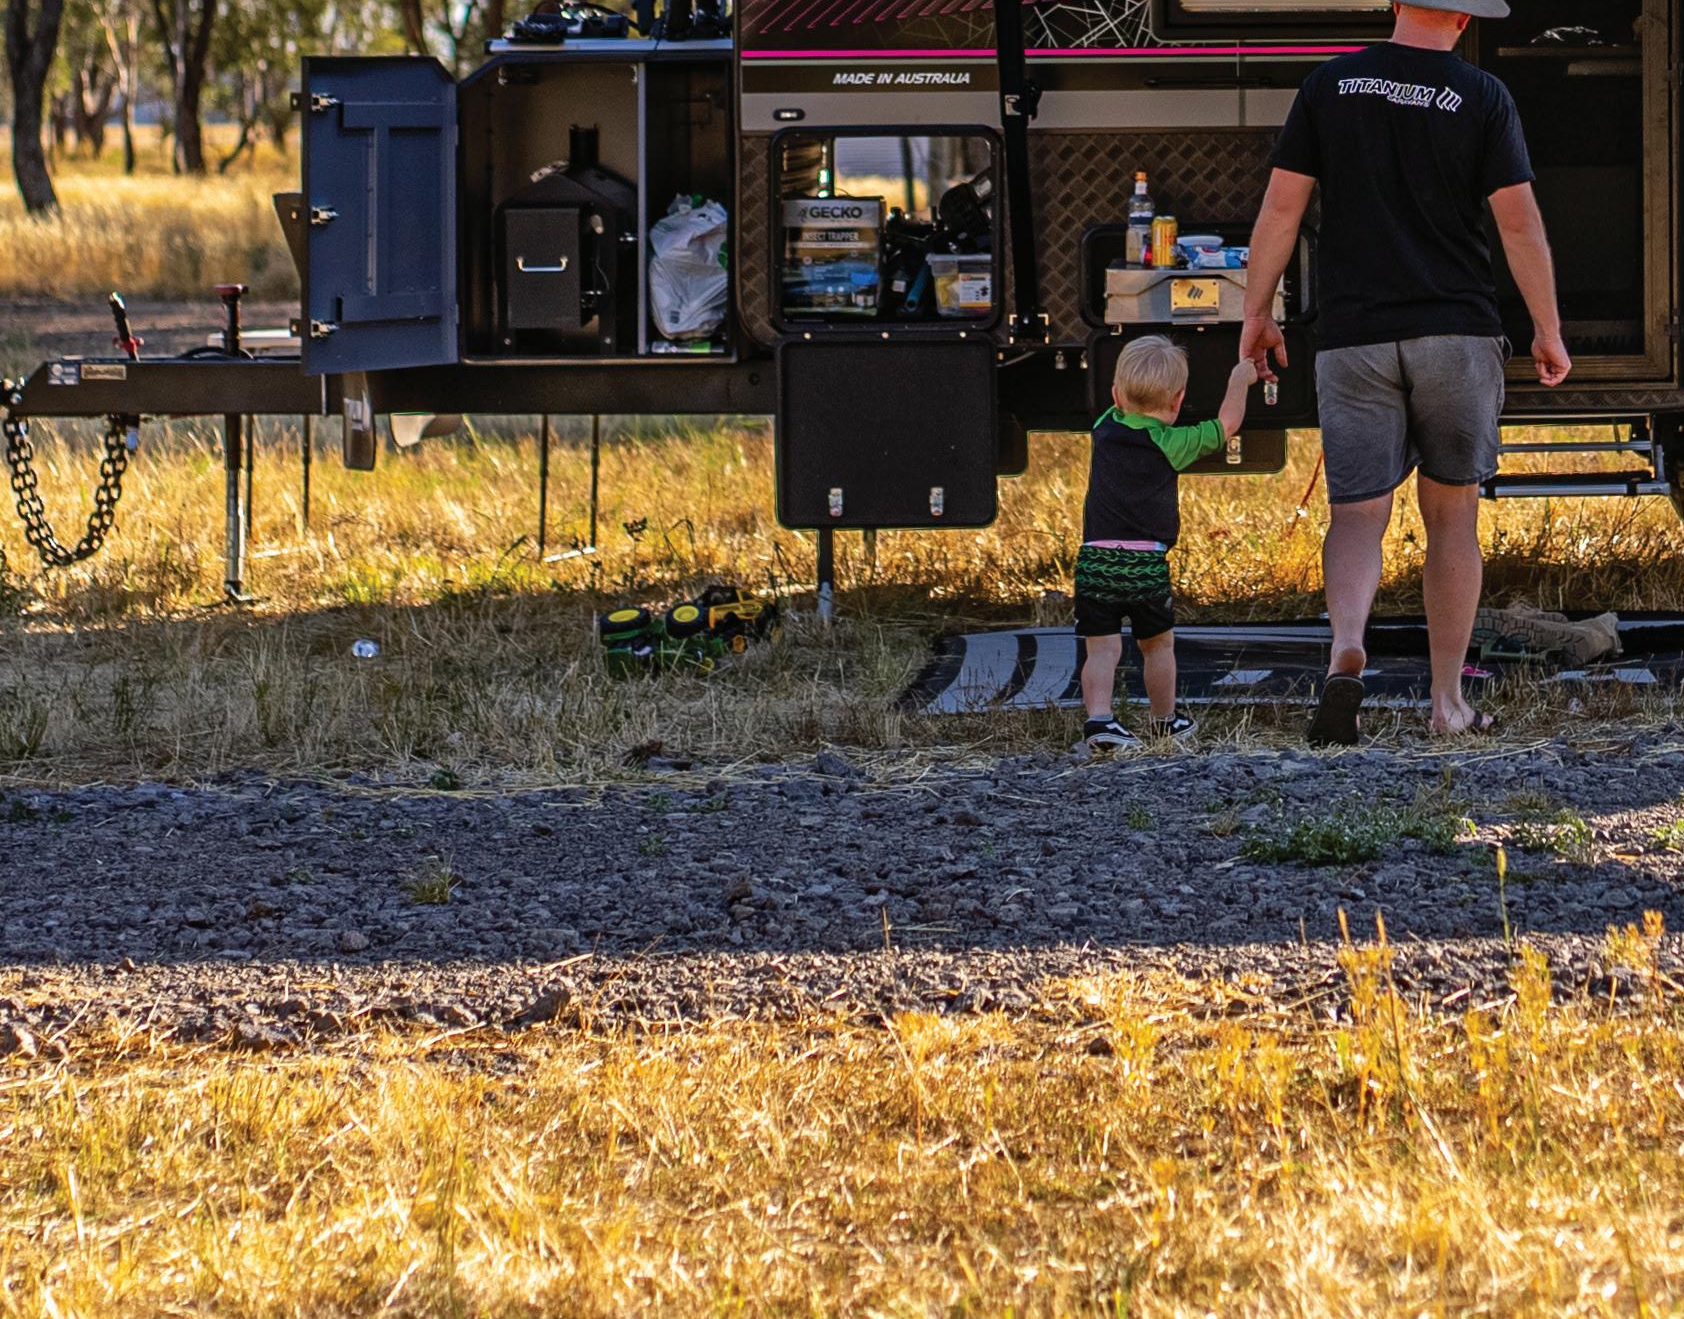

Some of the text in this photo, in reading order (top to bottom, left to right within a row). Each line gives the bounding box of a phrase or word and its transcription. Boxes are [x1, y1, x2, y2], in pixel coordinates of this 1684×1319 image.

[833, 73, 970, 84] MADE IN AUSTRALIA
[1338, 78, 1436, 103] TITANIUM
[809, 206, 863, 219] GECKO
